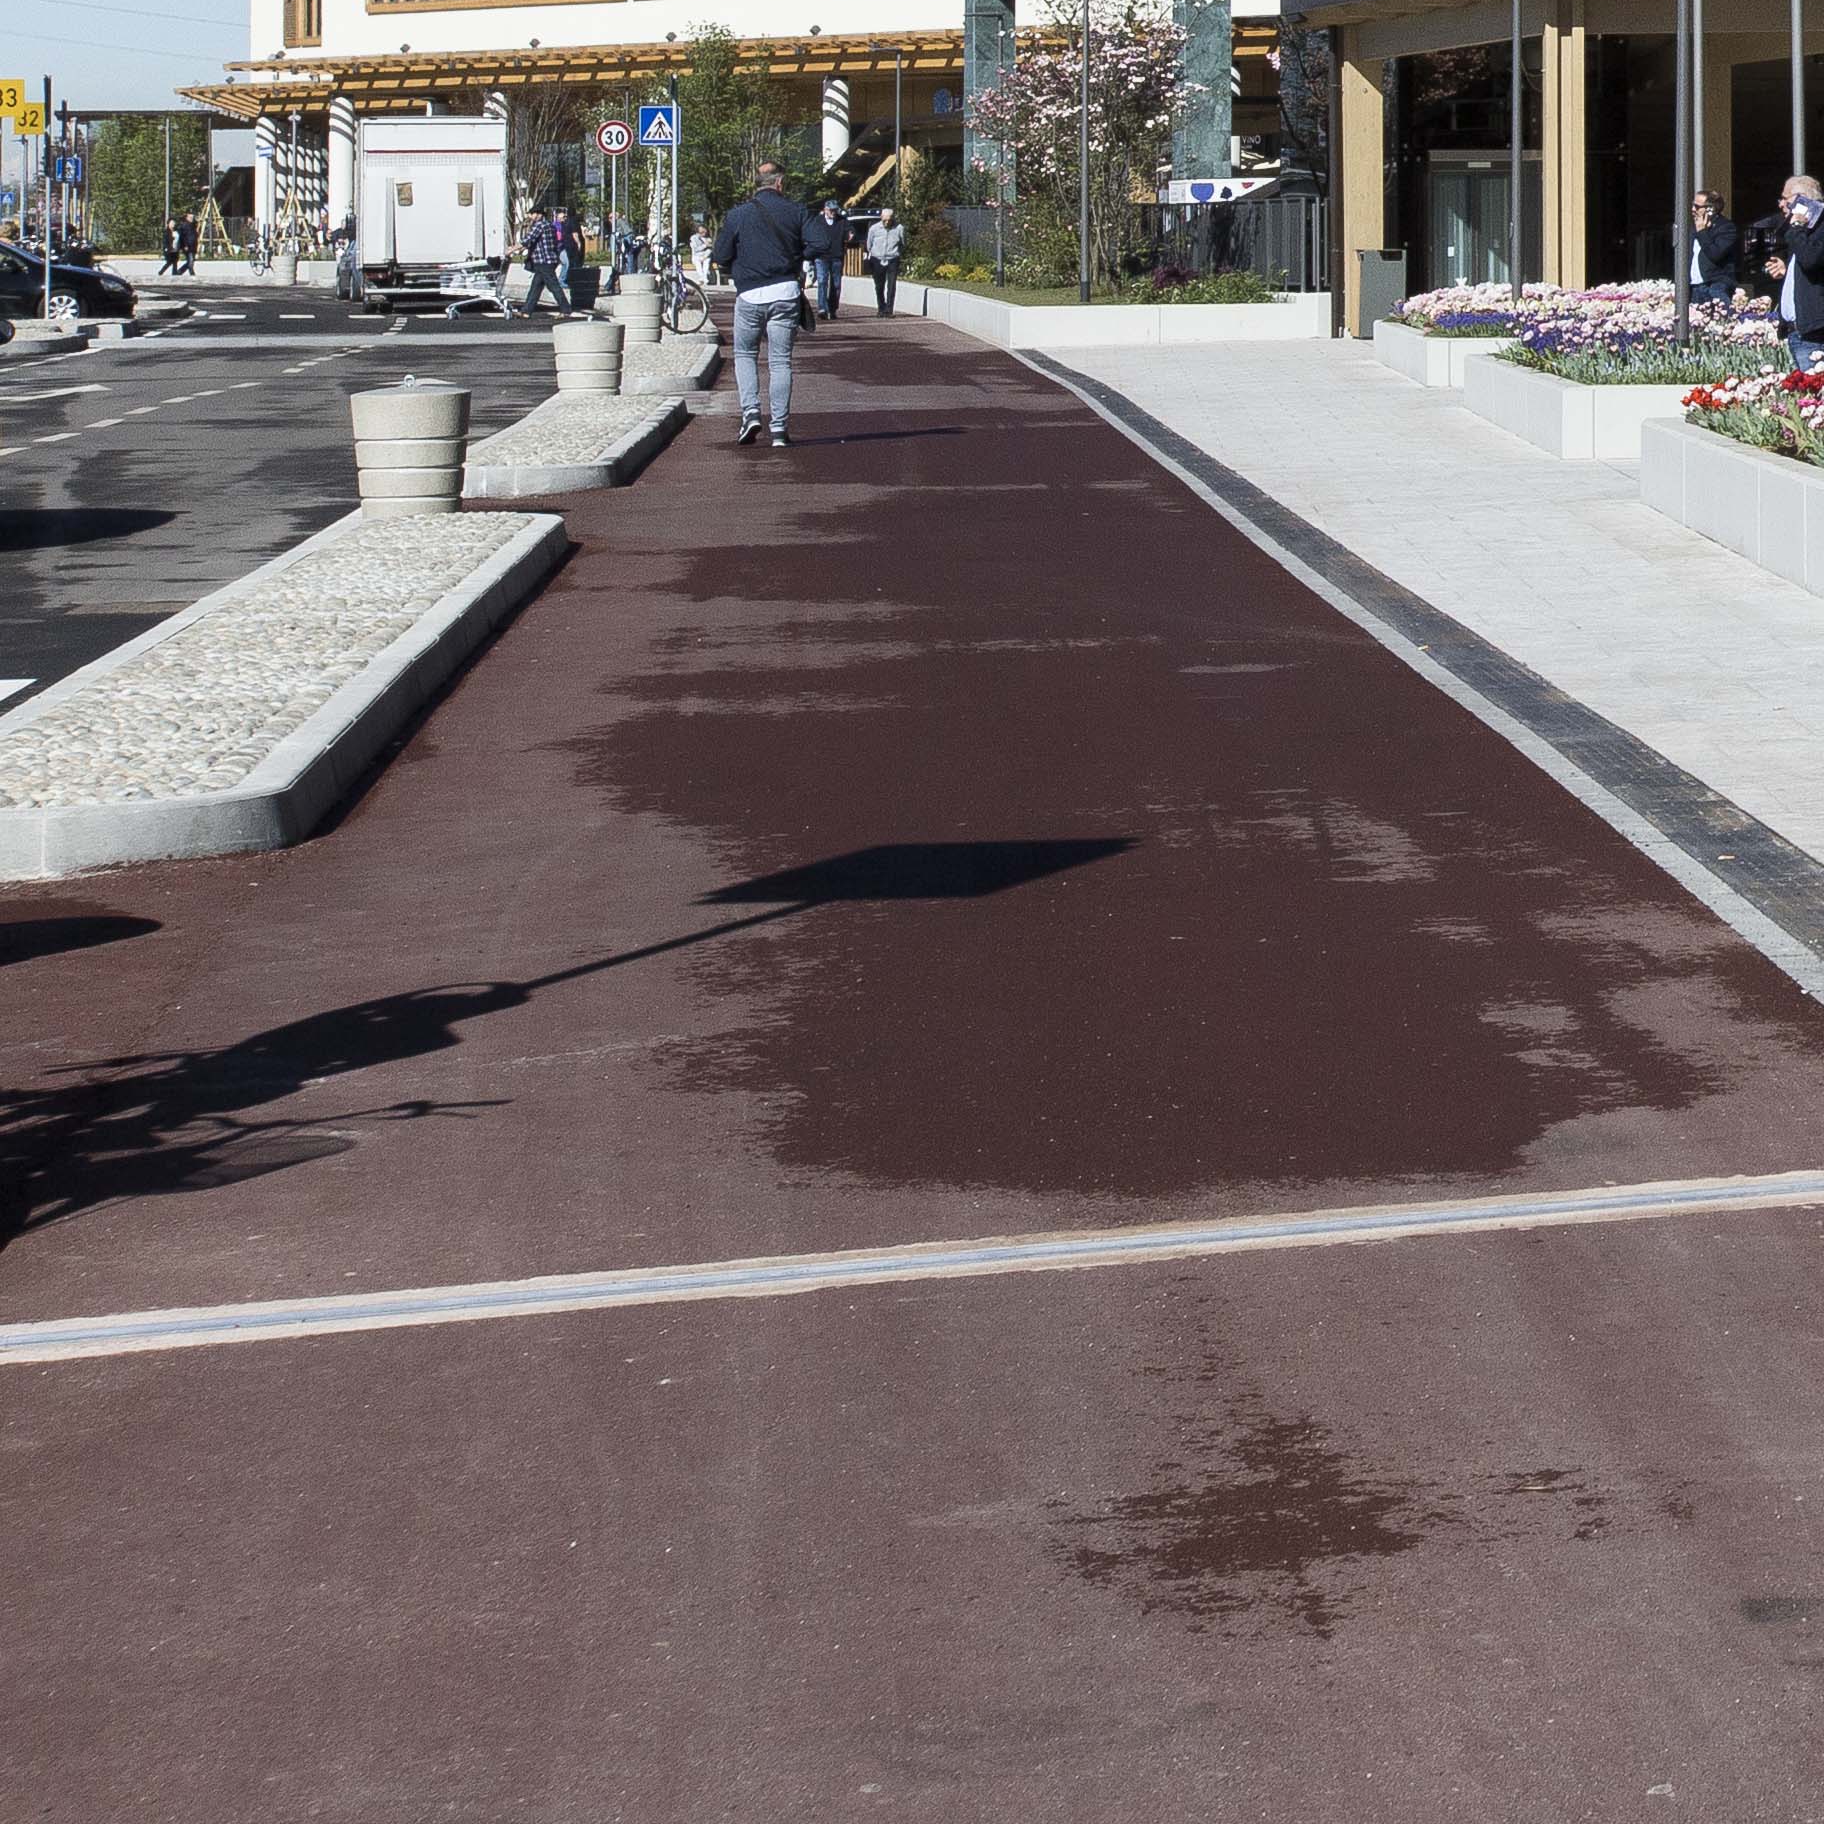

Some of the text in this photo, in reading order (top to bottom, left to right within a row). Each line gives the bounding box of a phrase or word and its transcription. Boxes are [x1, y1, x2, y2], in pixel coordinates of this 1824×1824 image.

[18, 110, 39, 127] 32
[604, 130, 625, 146] 30
[1242, 135, 1262, 145] VINO
